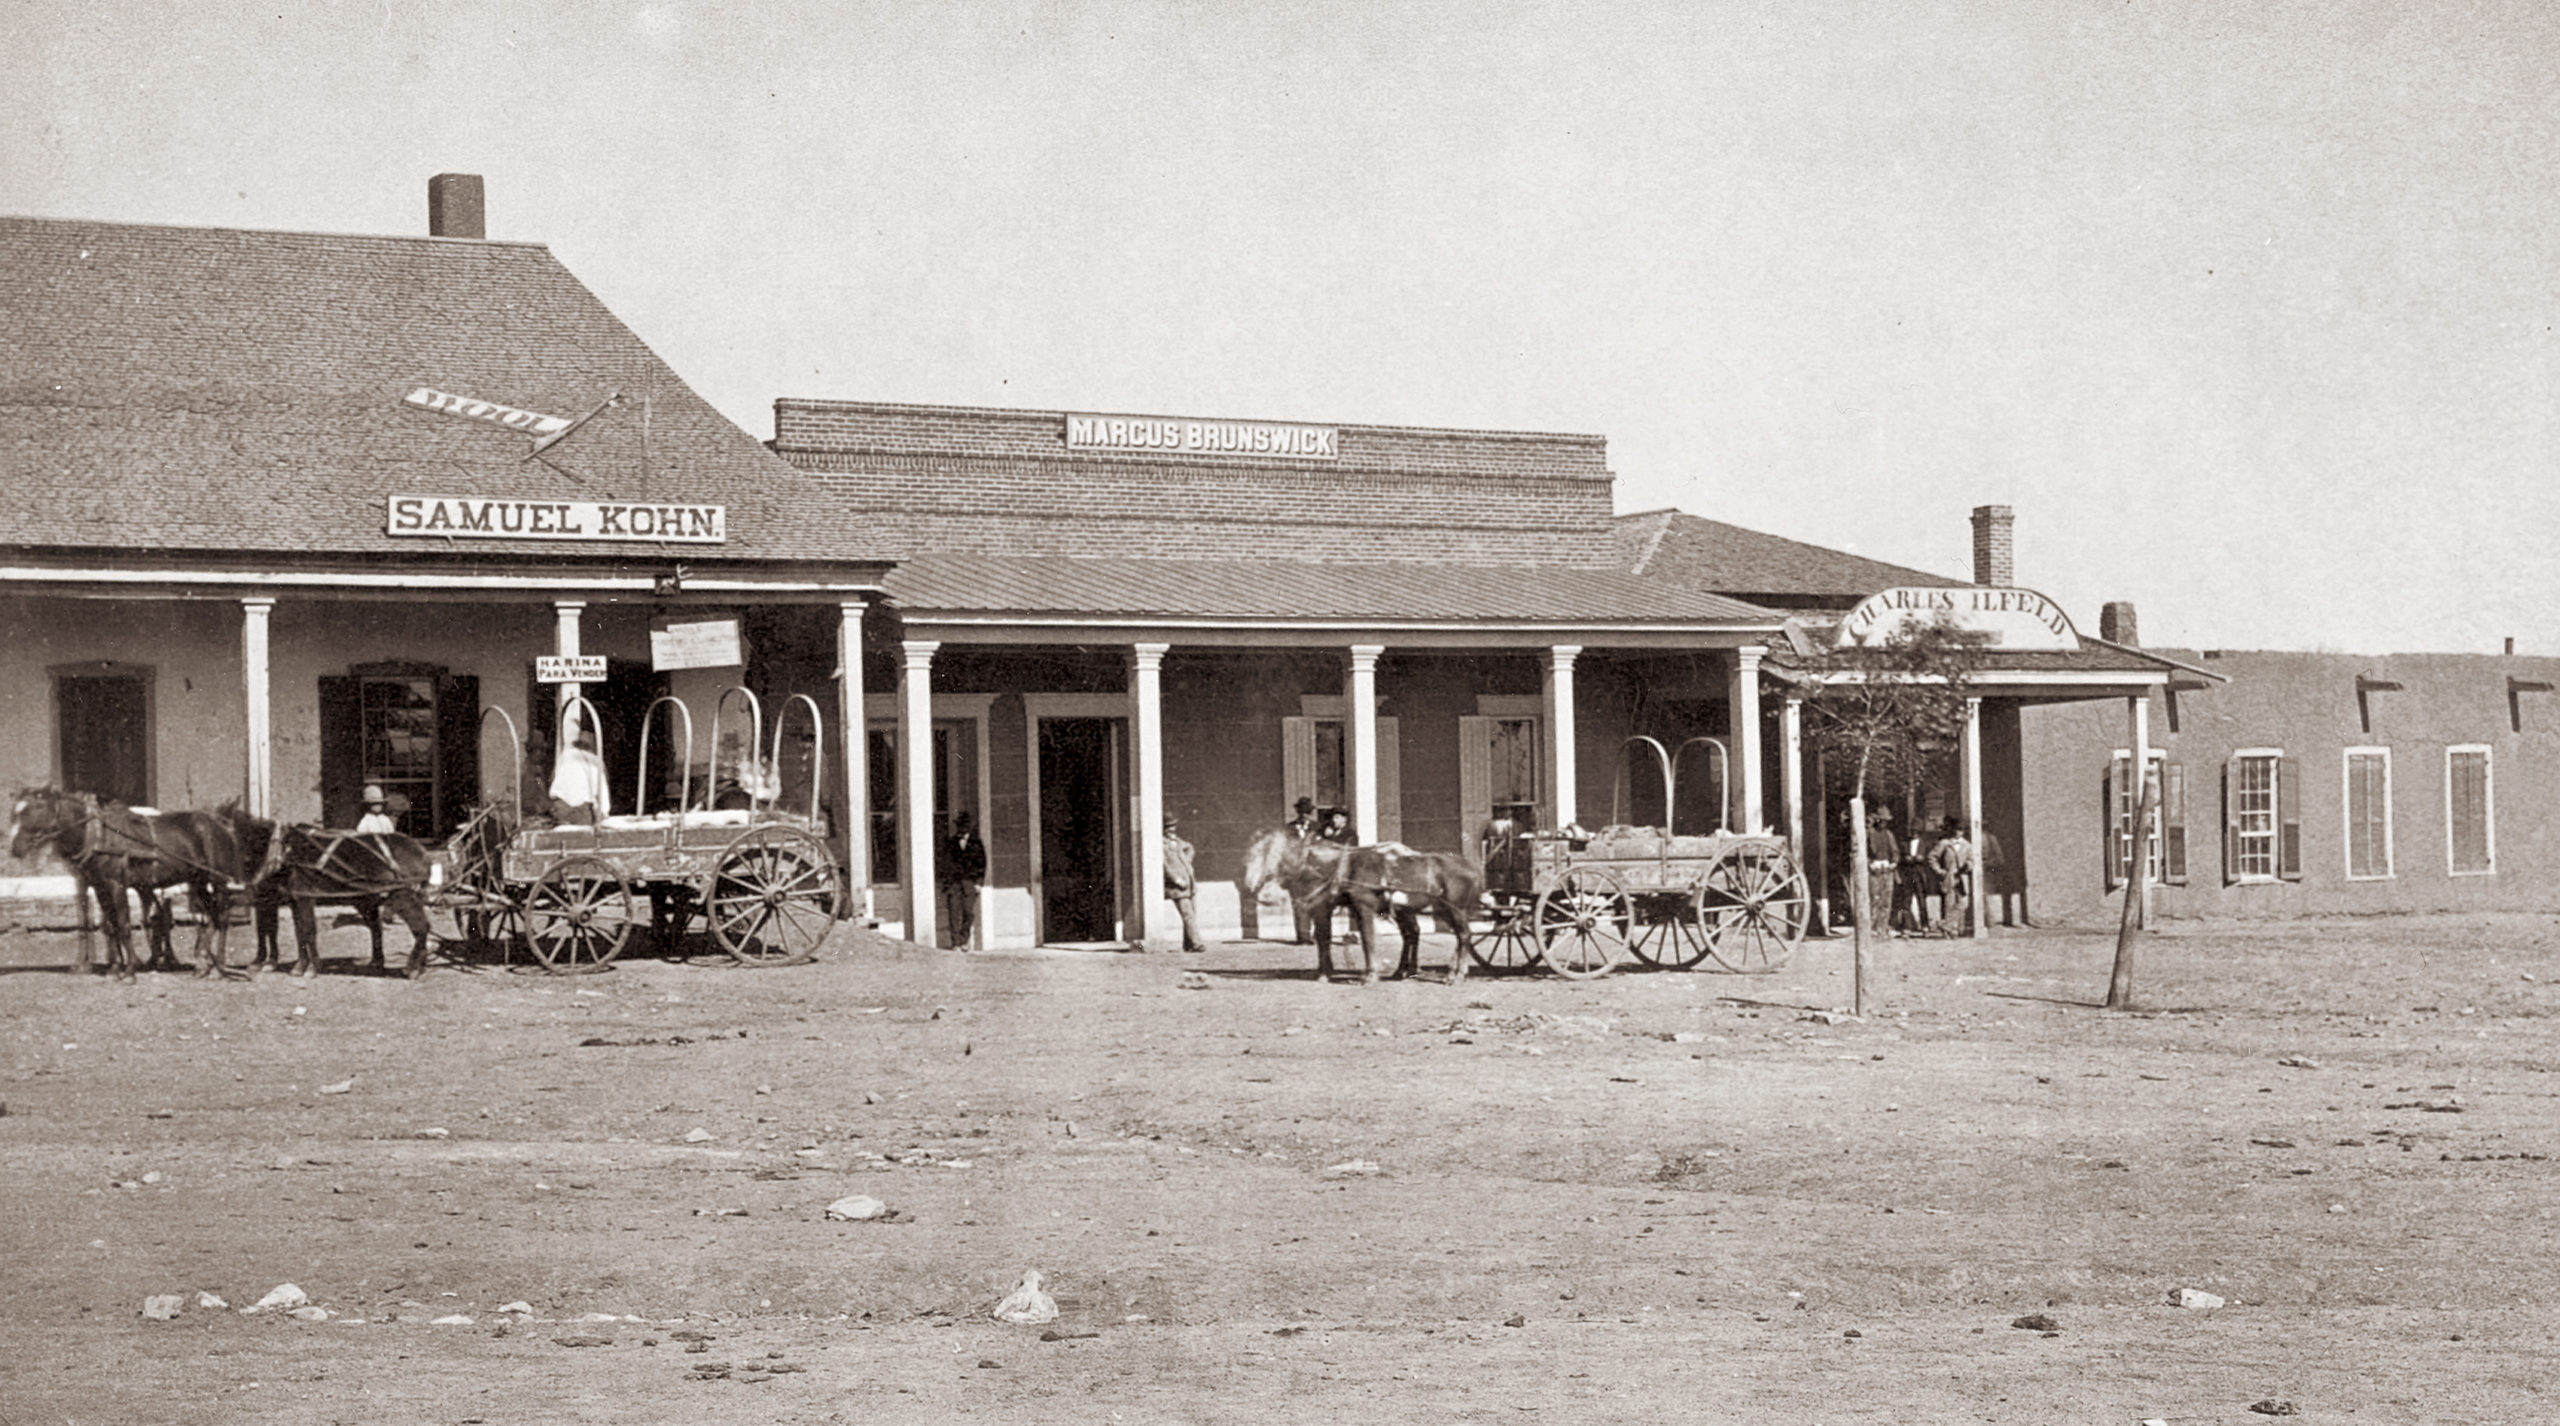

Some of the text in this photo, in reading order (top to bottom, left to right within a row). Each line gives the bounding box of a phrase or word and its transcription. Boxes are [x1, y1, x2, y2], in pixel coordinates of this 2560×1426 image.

[1072, 418, 1336, 457] MARCUS BRUNSWICK
[395, 499, 721, 538] SAMUEL KOHN.
[1849, 590, 1955, 641] CHARLES
[541, 659, 602, 667] HARINA
